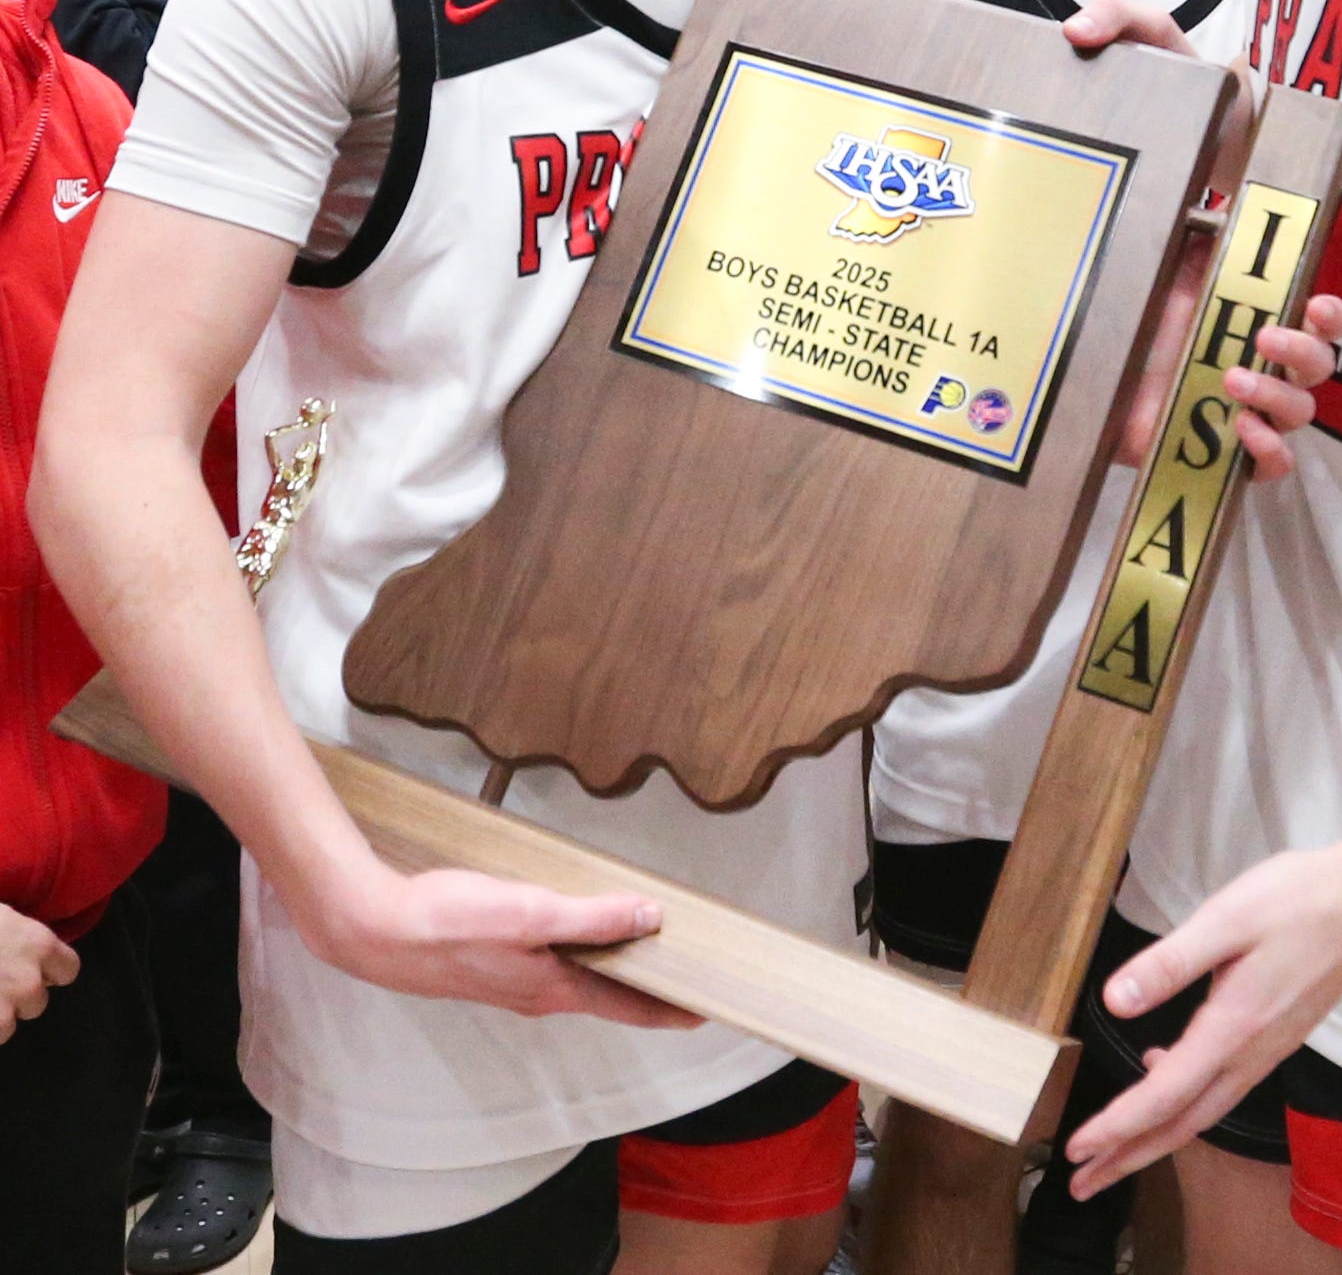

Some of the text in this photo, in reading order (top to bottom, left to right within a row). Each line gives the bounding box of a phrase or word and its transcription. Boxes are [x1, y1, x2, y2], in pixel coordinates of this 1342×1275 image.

[56, 178, 88, 203] NIKE
[706, 250, 1000, 360] BOYS BASKETBALL 1A
[832, 258, 892, 292] 2025
[752, 326, 911, 395] CHAMPIONS
[758, 297, 822, 335] SEMI
[843, 324, 927, 368] STATE
